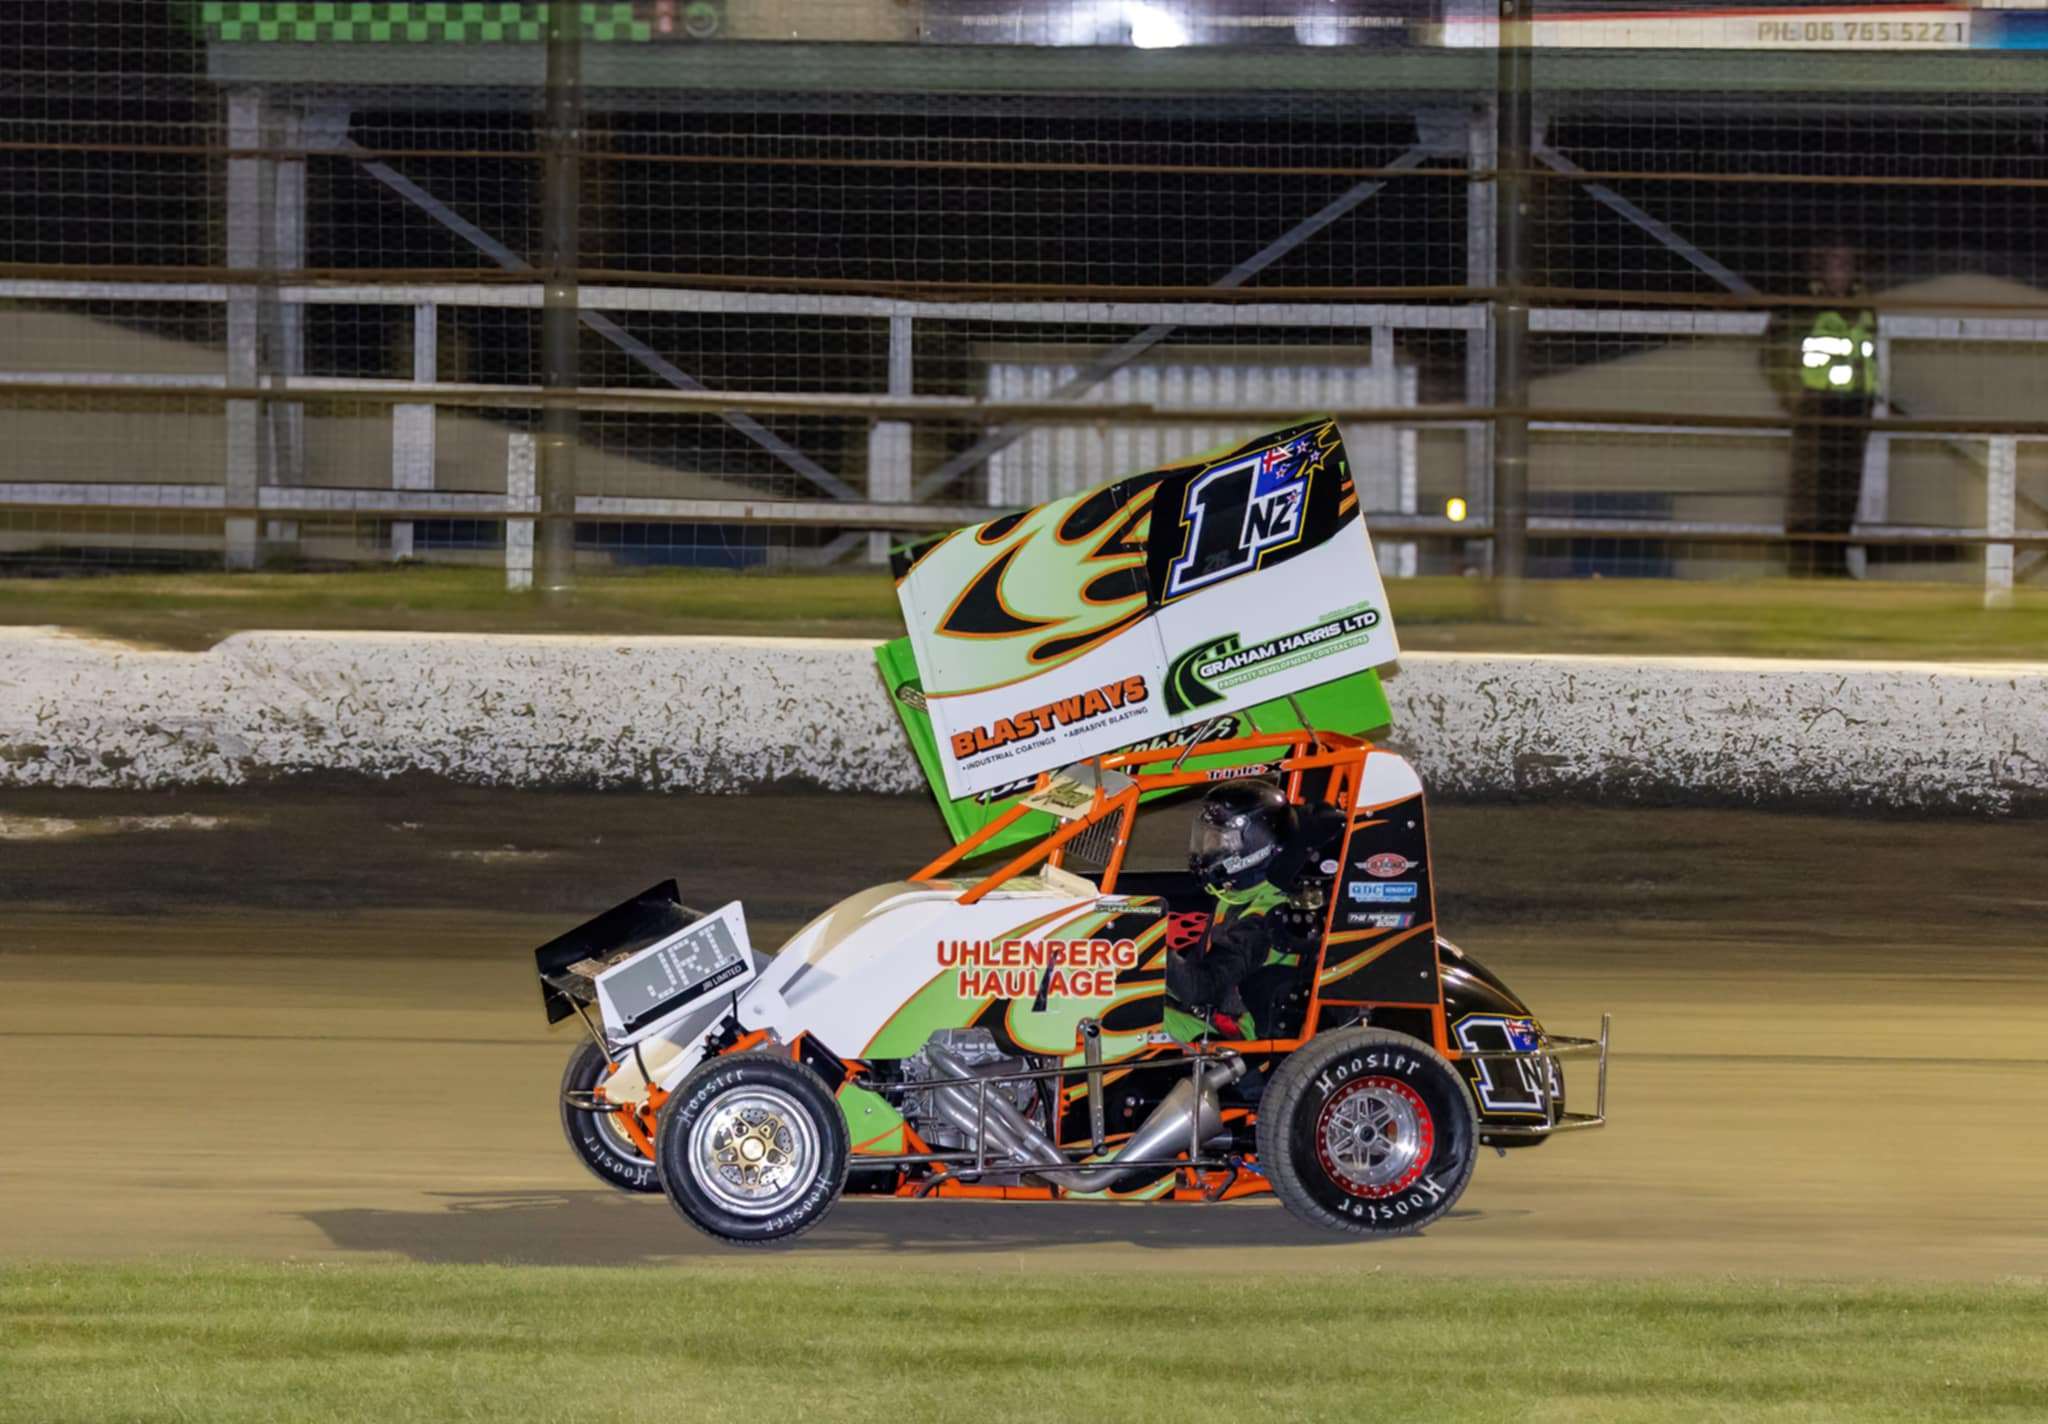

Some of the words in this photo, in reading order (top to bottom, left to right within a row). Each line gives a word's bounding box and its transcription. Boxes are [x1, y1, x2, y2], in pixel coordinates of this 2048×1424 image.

[1844, 22, 1890, 42] 765
[1168, 455, 1262, 596] 1
[1199, 642, 1276, 679] GRAHAM
[1279, 622, 1341, 653] HARRIS
[1344, 610, 1377, 632] LTD
[951, 675, 1149, 760] BLASTWAYS
[965, 751, 1014, 770] INDUSTRIAL
[1015, 736, 1056, 755] COATINGS
[1069, 720, 1108, 738] ABRASIVE
[1109, 706, 1148, 725] BLASTING
[712, 965, 742, 986] LIMITED
[936, 939, 1137, 968] UHLENBERG
[1315, 1051, 1421, 1099] Hoosier
[1337, 1175, 1447, 1224] Hoosier
